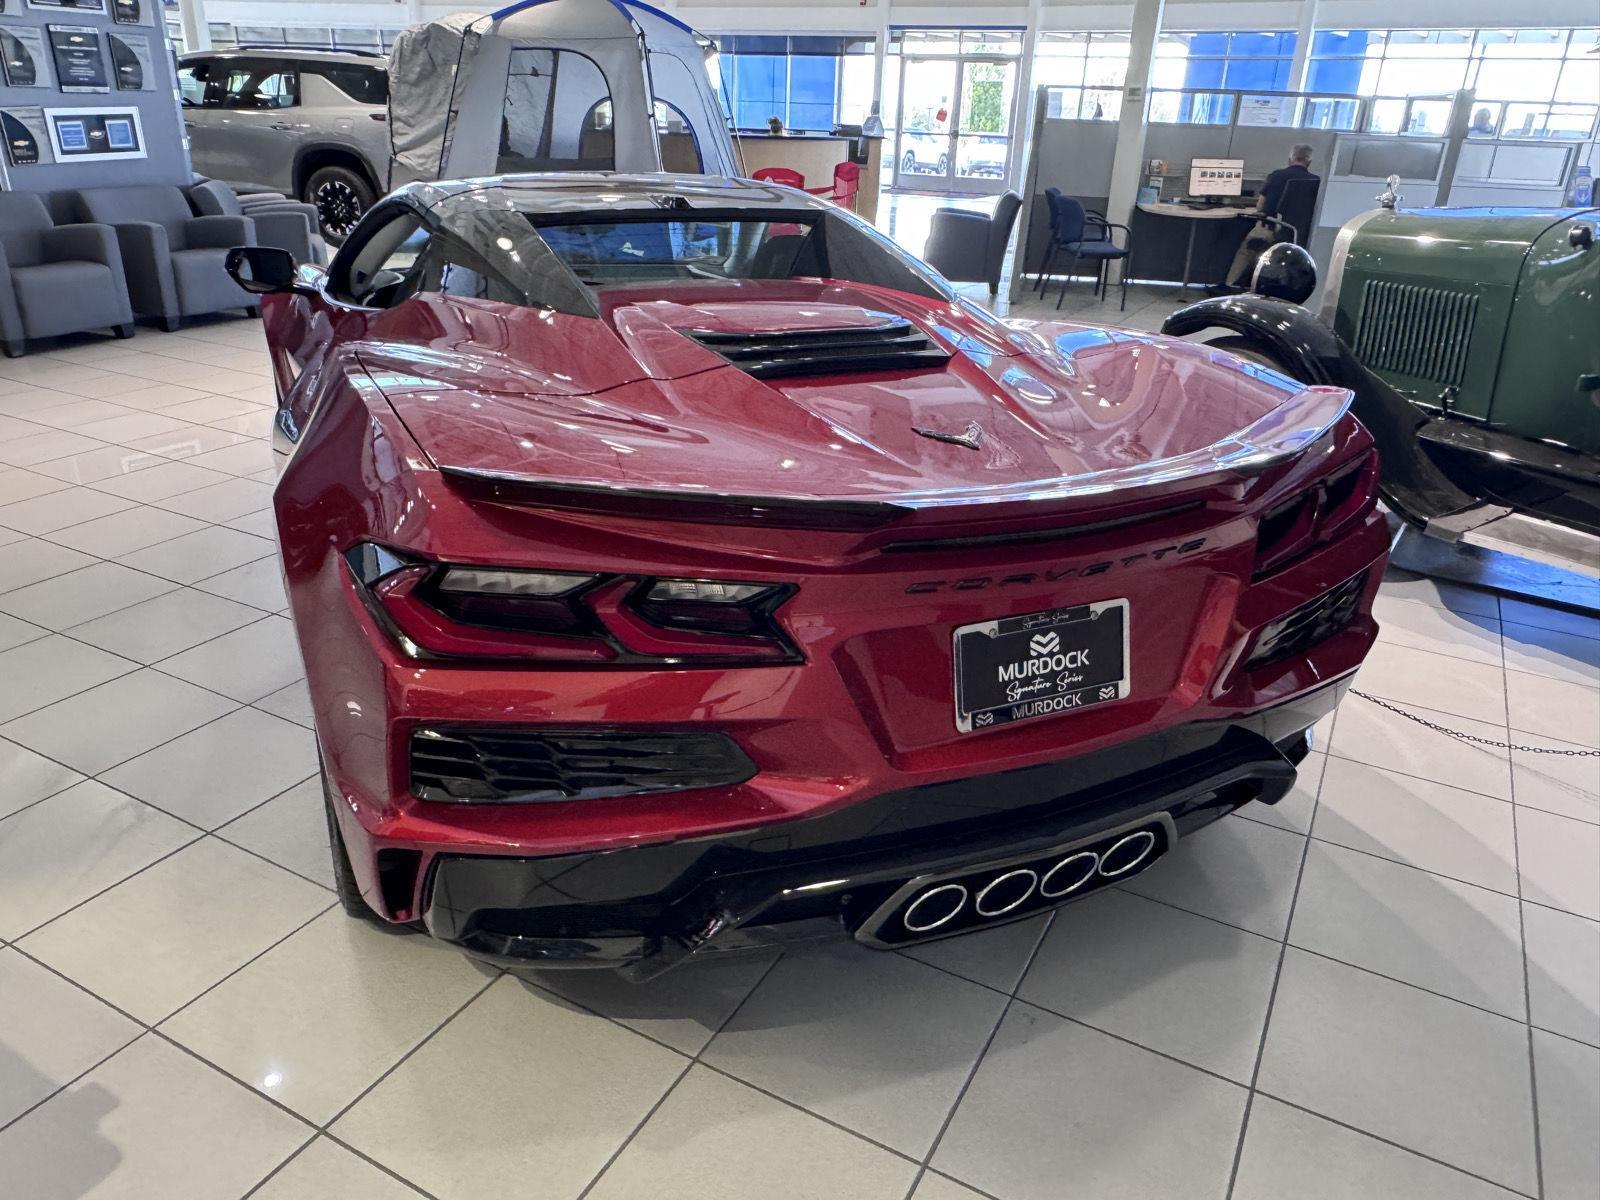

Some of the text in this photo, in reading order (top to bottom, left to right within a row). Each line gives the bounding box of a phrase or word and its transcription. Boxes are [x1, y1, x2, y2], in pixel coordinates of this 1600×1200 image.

[905, 537, 1206, 593] CORVETTE
[998, 648, 1090, 683] MURDOCK
[1006, 671, 1084, 702] Signature Series
[1011, 693, 1082, 720] MURDOCK
